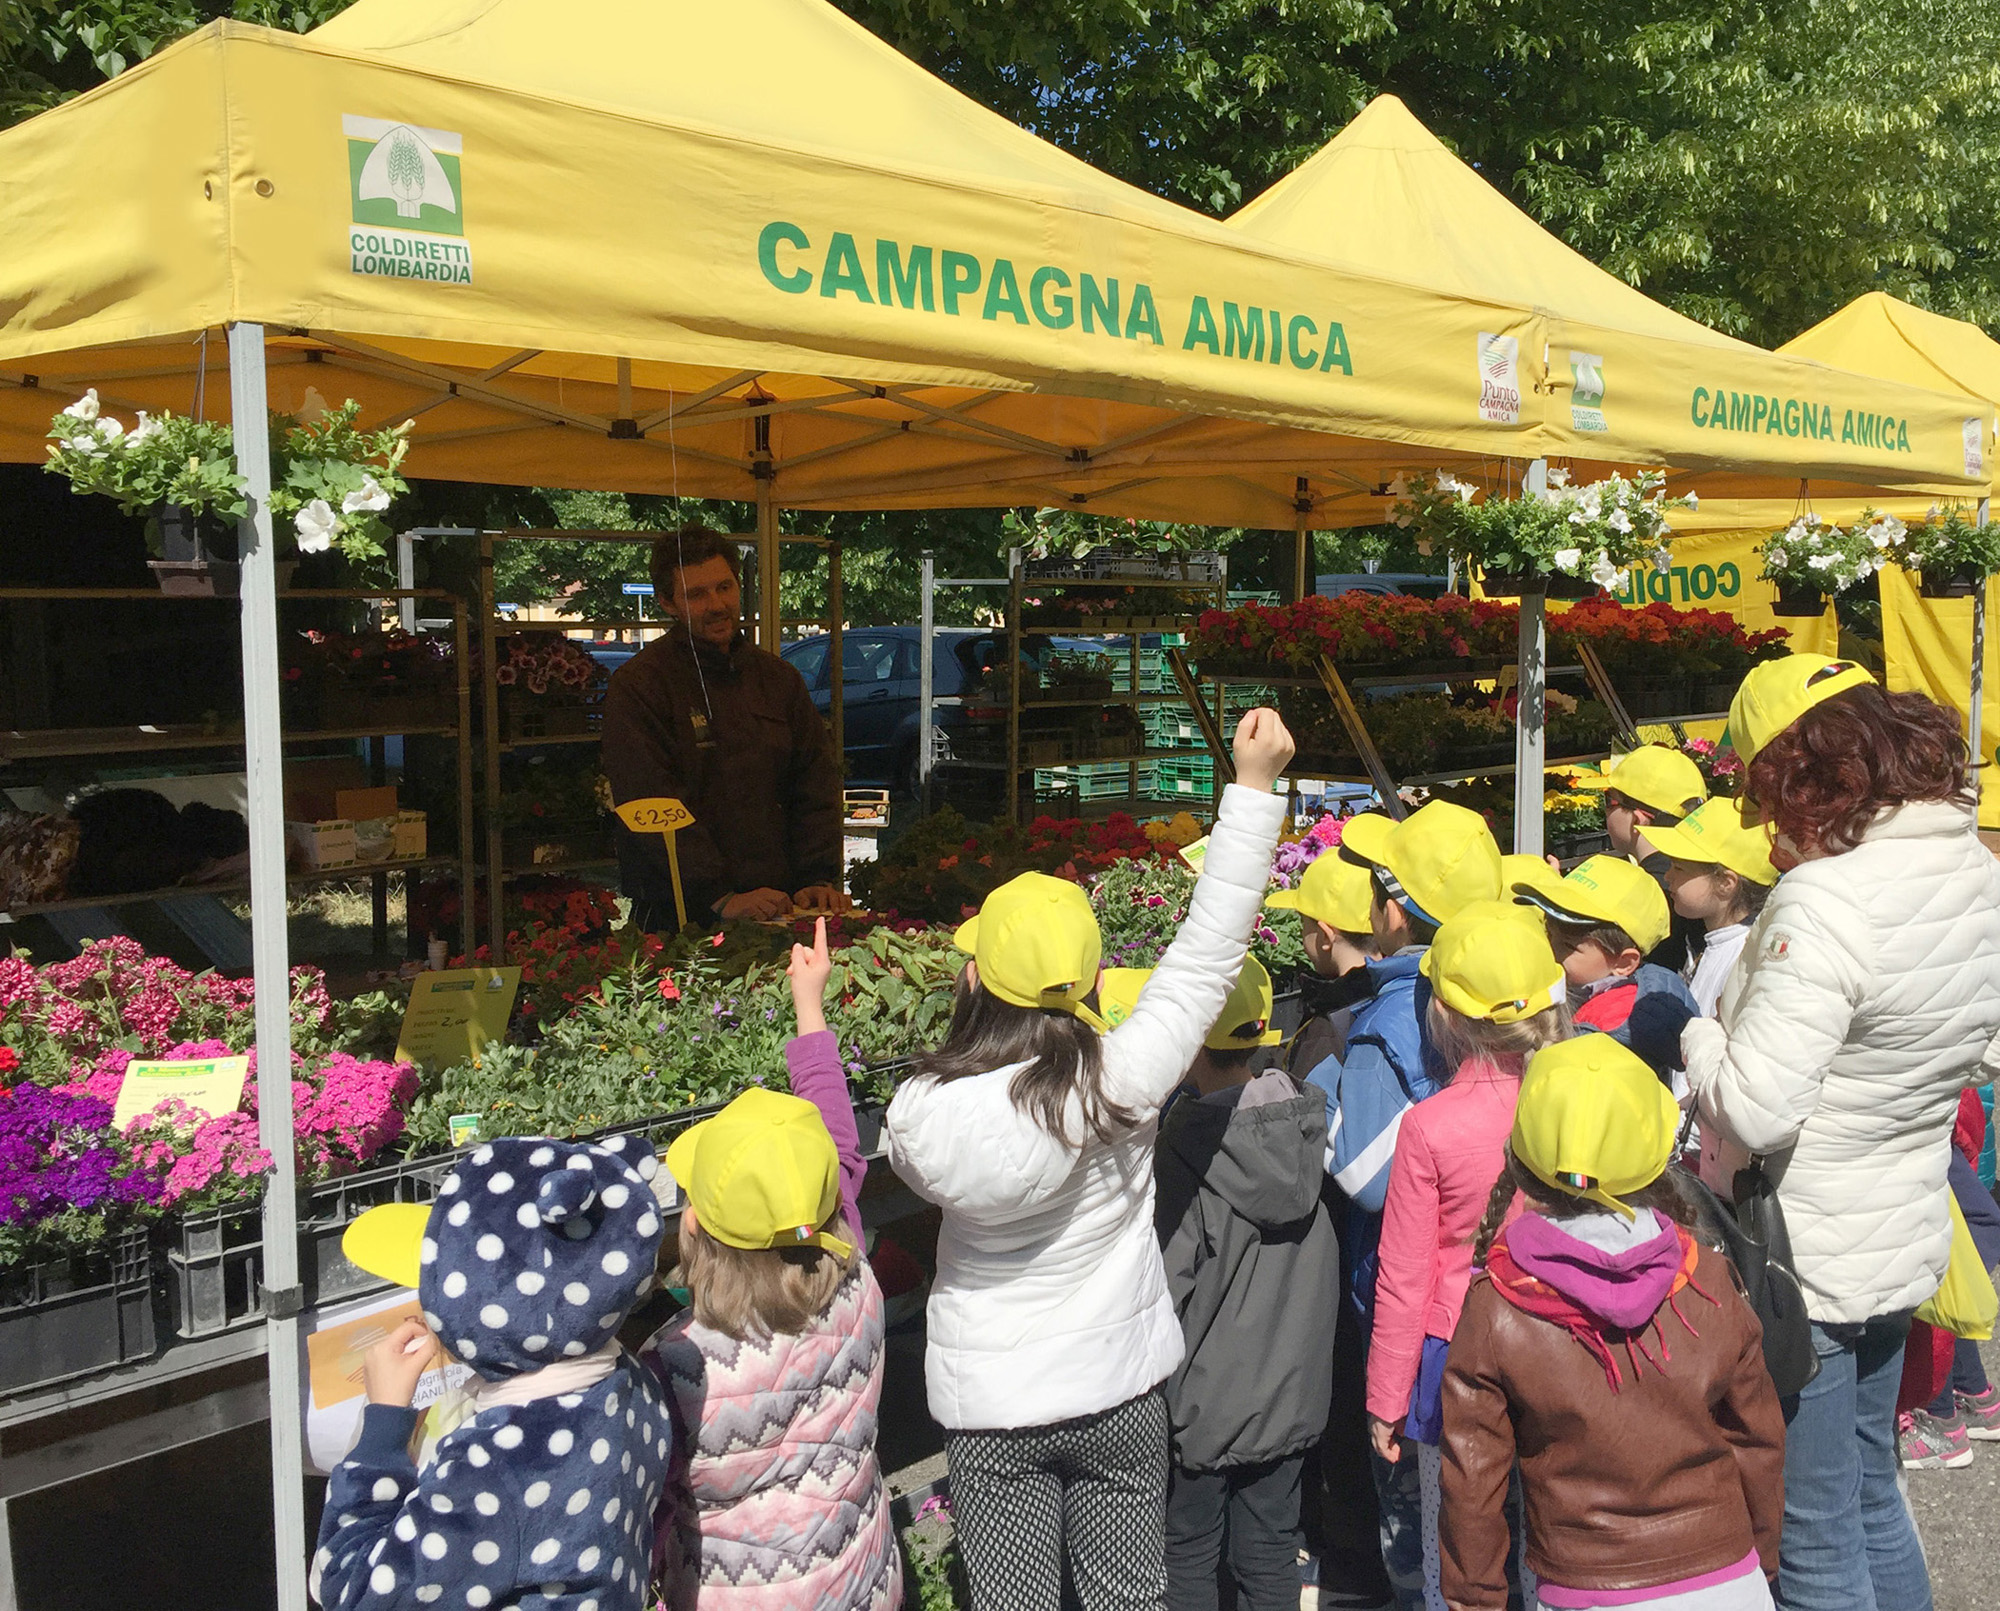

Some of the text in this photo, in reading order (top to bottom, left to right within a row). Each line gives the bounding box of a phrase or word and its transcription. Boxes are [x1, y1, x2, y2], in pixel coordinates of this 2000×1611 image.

[351, 233, 470, 263] COLDIRETTI
[352, 255, 472, 284] LOMBARDIA
[757, 221, 1354, 376] CAMPAGNA AMICA
[1479, 398, 1519, 413] CAMPAGNA
[1487, 410, 1510, 422] AMICA
[1691, 386, 1912, 453] CAMPAGNA AMICA
